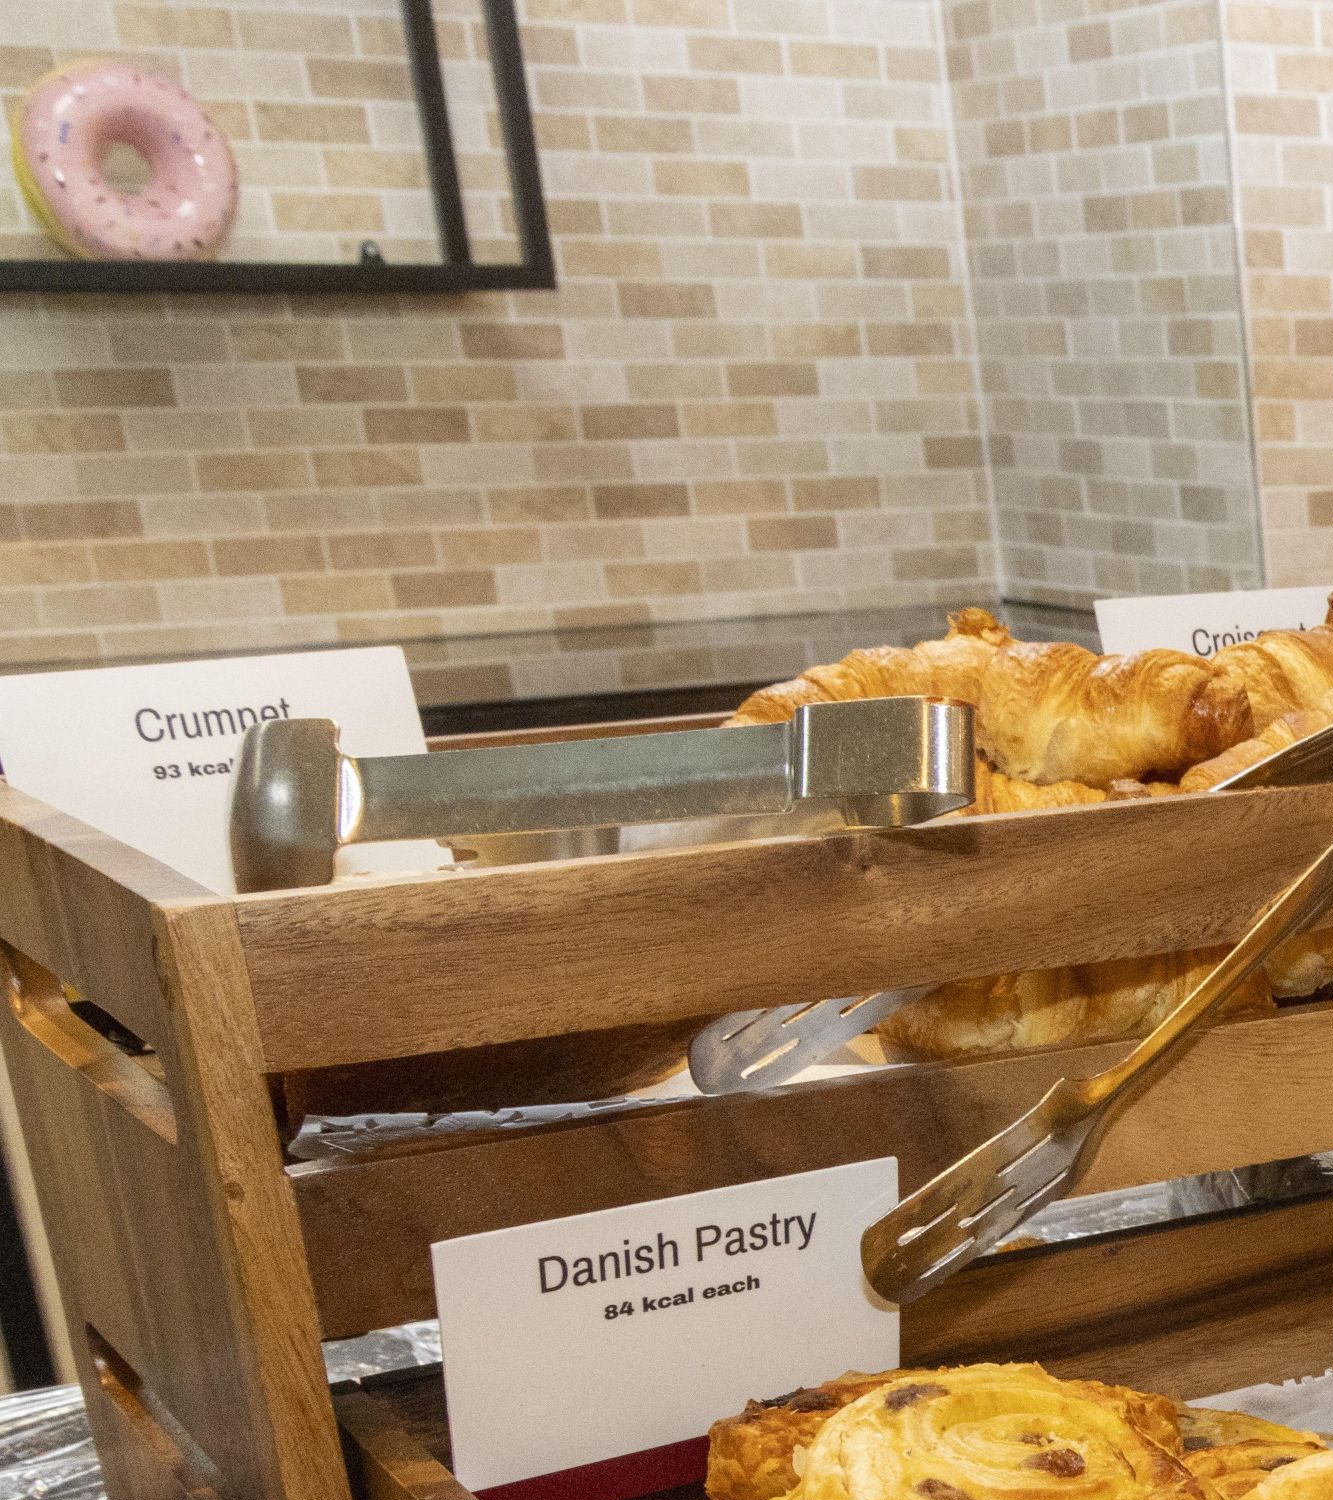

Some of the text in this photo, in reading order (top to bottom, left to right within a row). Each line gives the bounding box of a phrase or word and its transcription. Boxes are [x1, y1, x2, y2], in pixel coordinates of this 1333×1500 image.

[153, 764, 182, 780] 93
[538, 1212, 817, 1294] Danish Pastry
[604, 1275, 760, 1320] 84 kcal each
